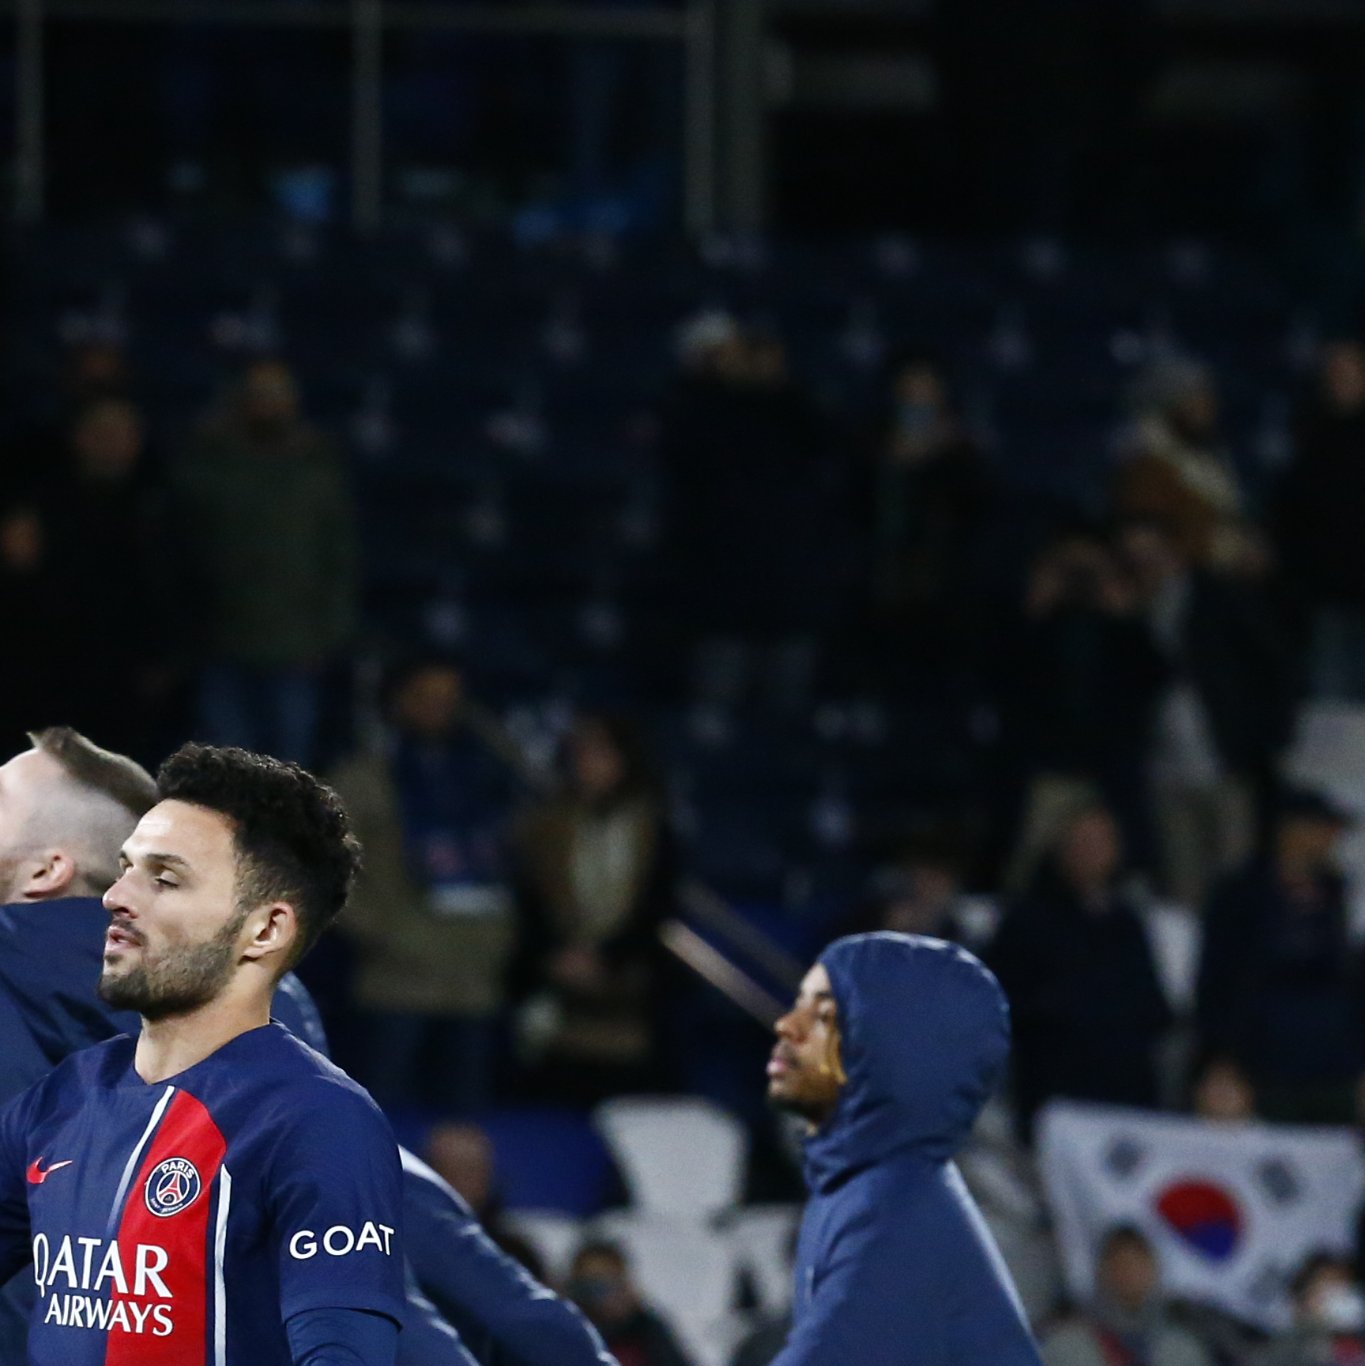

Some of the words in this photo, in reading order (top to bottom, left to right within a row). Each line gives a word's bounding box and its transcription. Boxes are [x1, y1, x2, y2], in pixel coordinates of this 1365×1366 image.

[161, 1161, 194, 1179] PARIS
[289, 1221, 394, 1259] GOAT
[33, 1233, 173, 1297] QATAR
[45, 1293, 173, 1336] AIRWAYS
